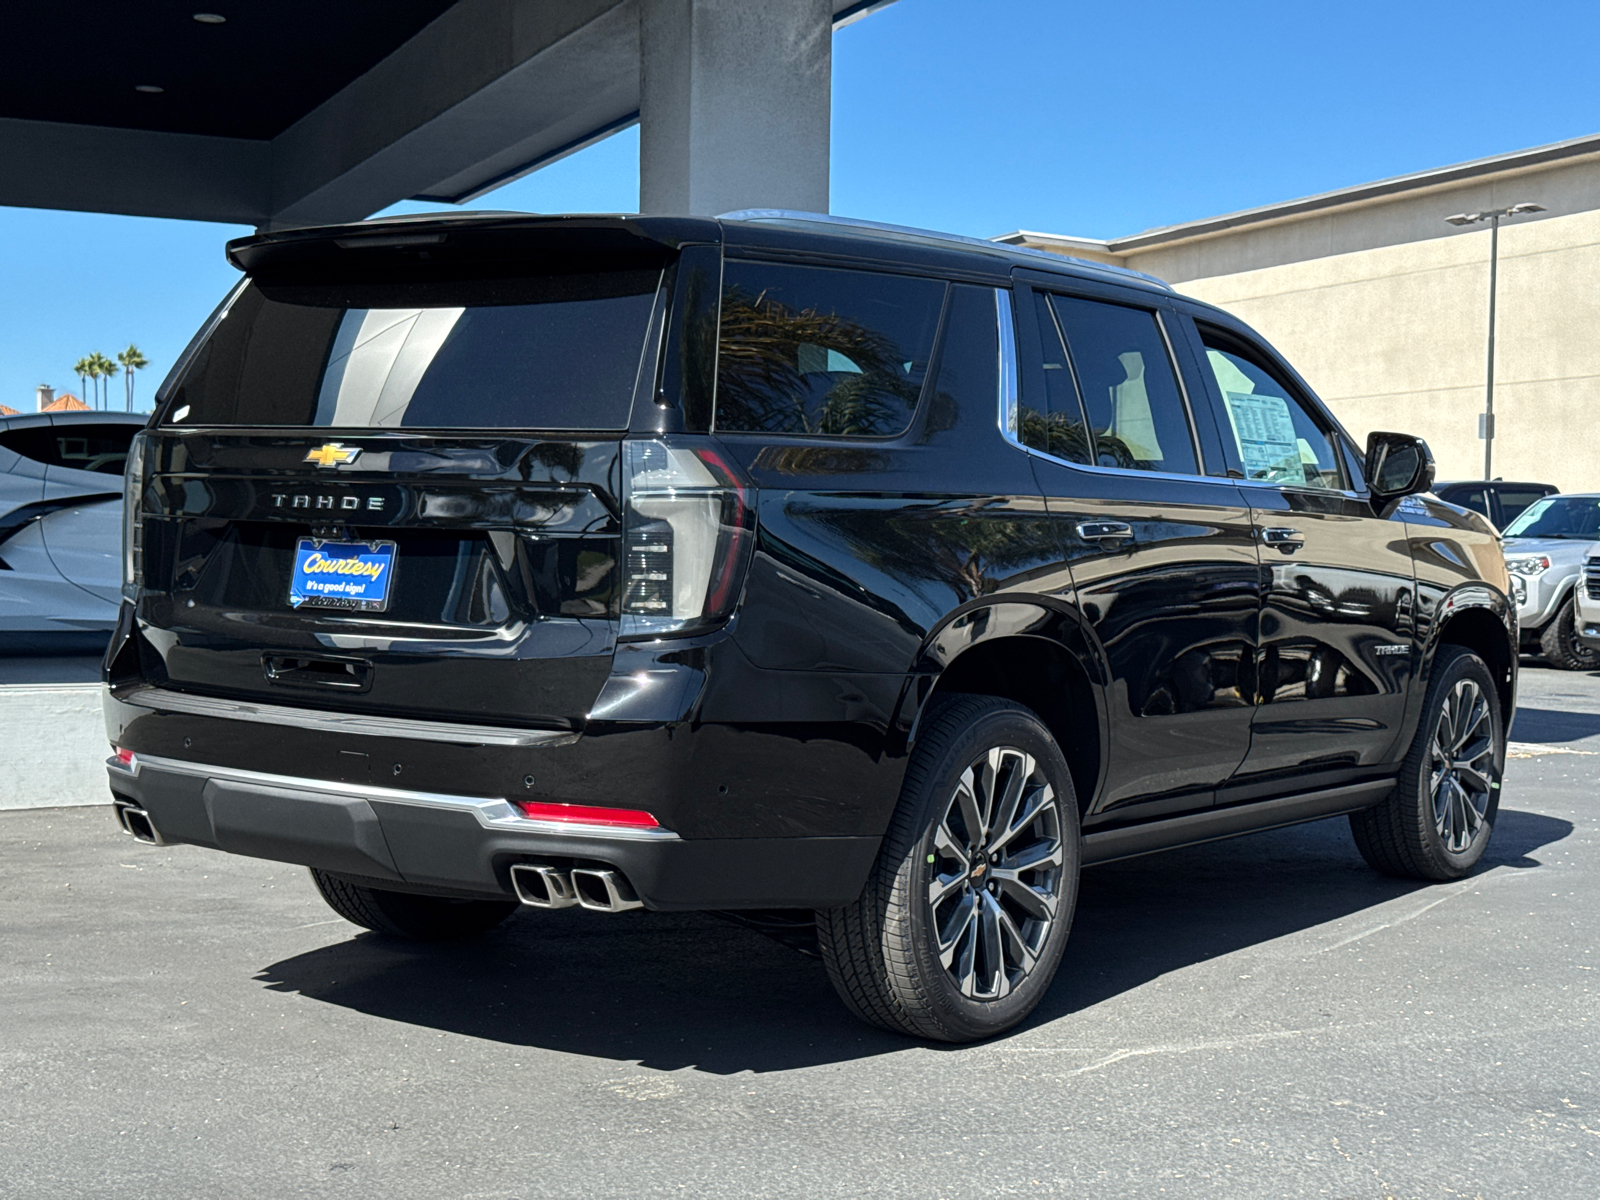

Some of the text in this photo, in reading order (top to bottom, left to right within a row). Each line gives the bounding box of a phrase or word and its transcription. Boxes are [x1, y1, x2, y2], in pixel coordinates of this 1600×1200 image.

[271, 494, 385, 510] TAHOE
[303, 553, 385, 582] Courtesy
[306, 580, 318, 590] It's
[323, 582, 345, 593] good
[345, 583, 366, 595] sign!
[1374, 644, 1409, 655] TAHOE
